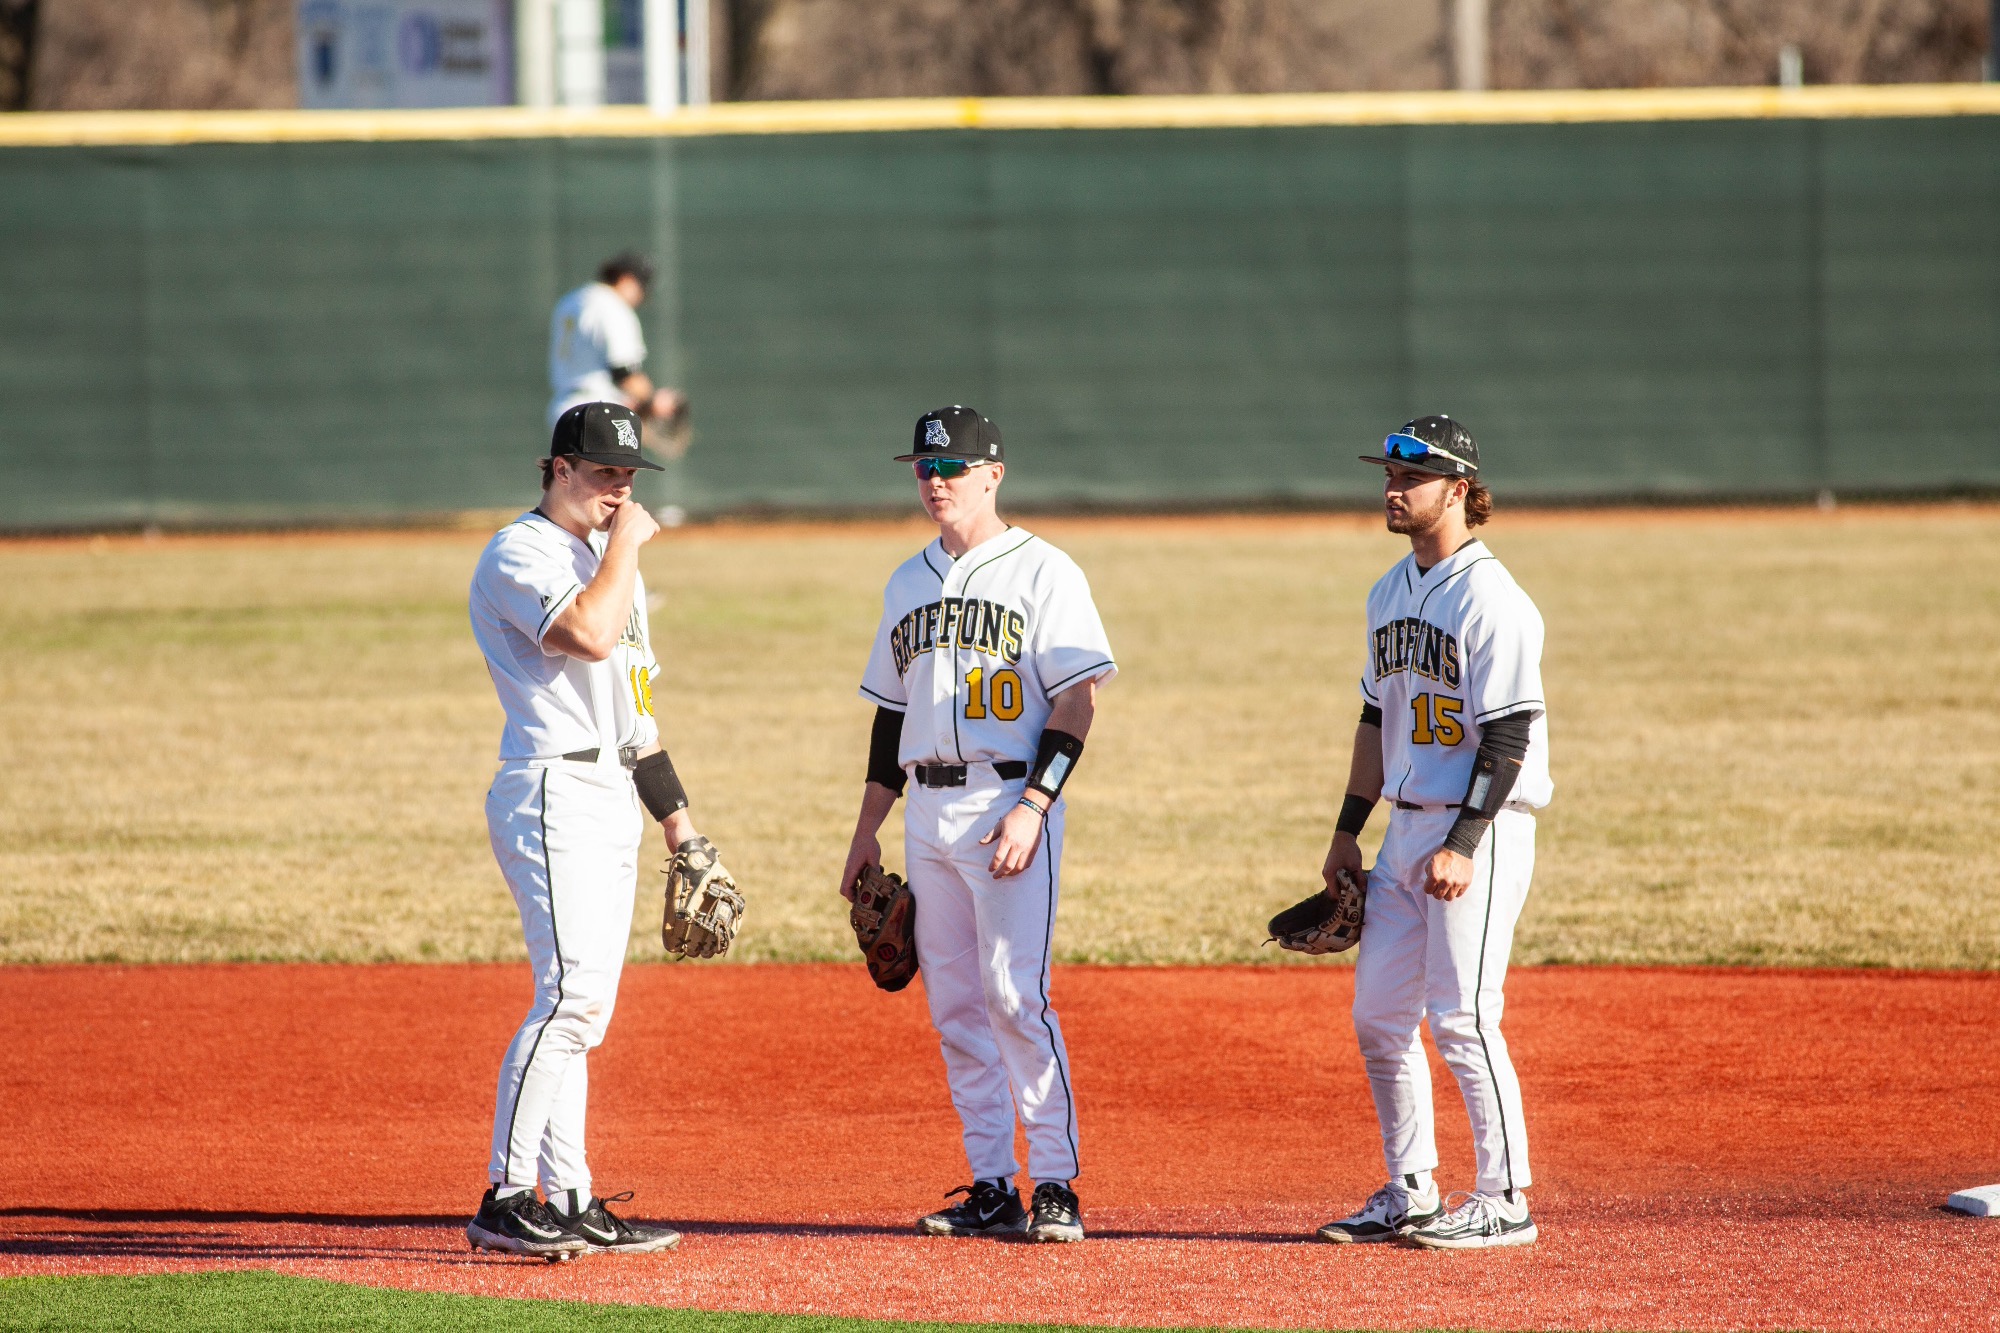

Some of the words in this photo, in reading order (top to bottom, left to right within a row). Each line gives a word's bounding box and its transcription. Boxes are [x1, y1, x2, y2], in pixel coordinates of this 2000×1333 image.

[890, 596, 1025, 685] GRIFFONS
[964, 666, 1025, 722] 10
[1411, 692, 1465, 747] 15
